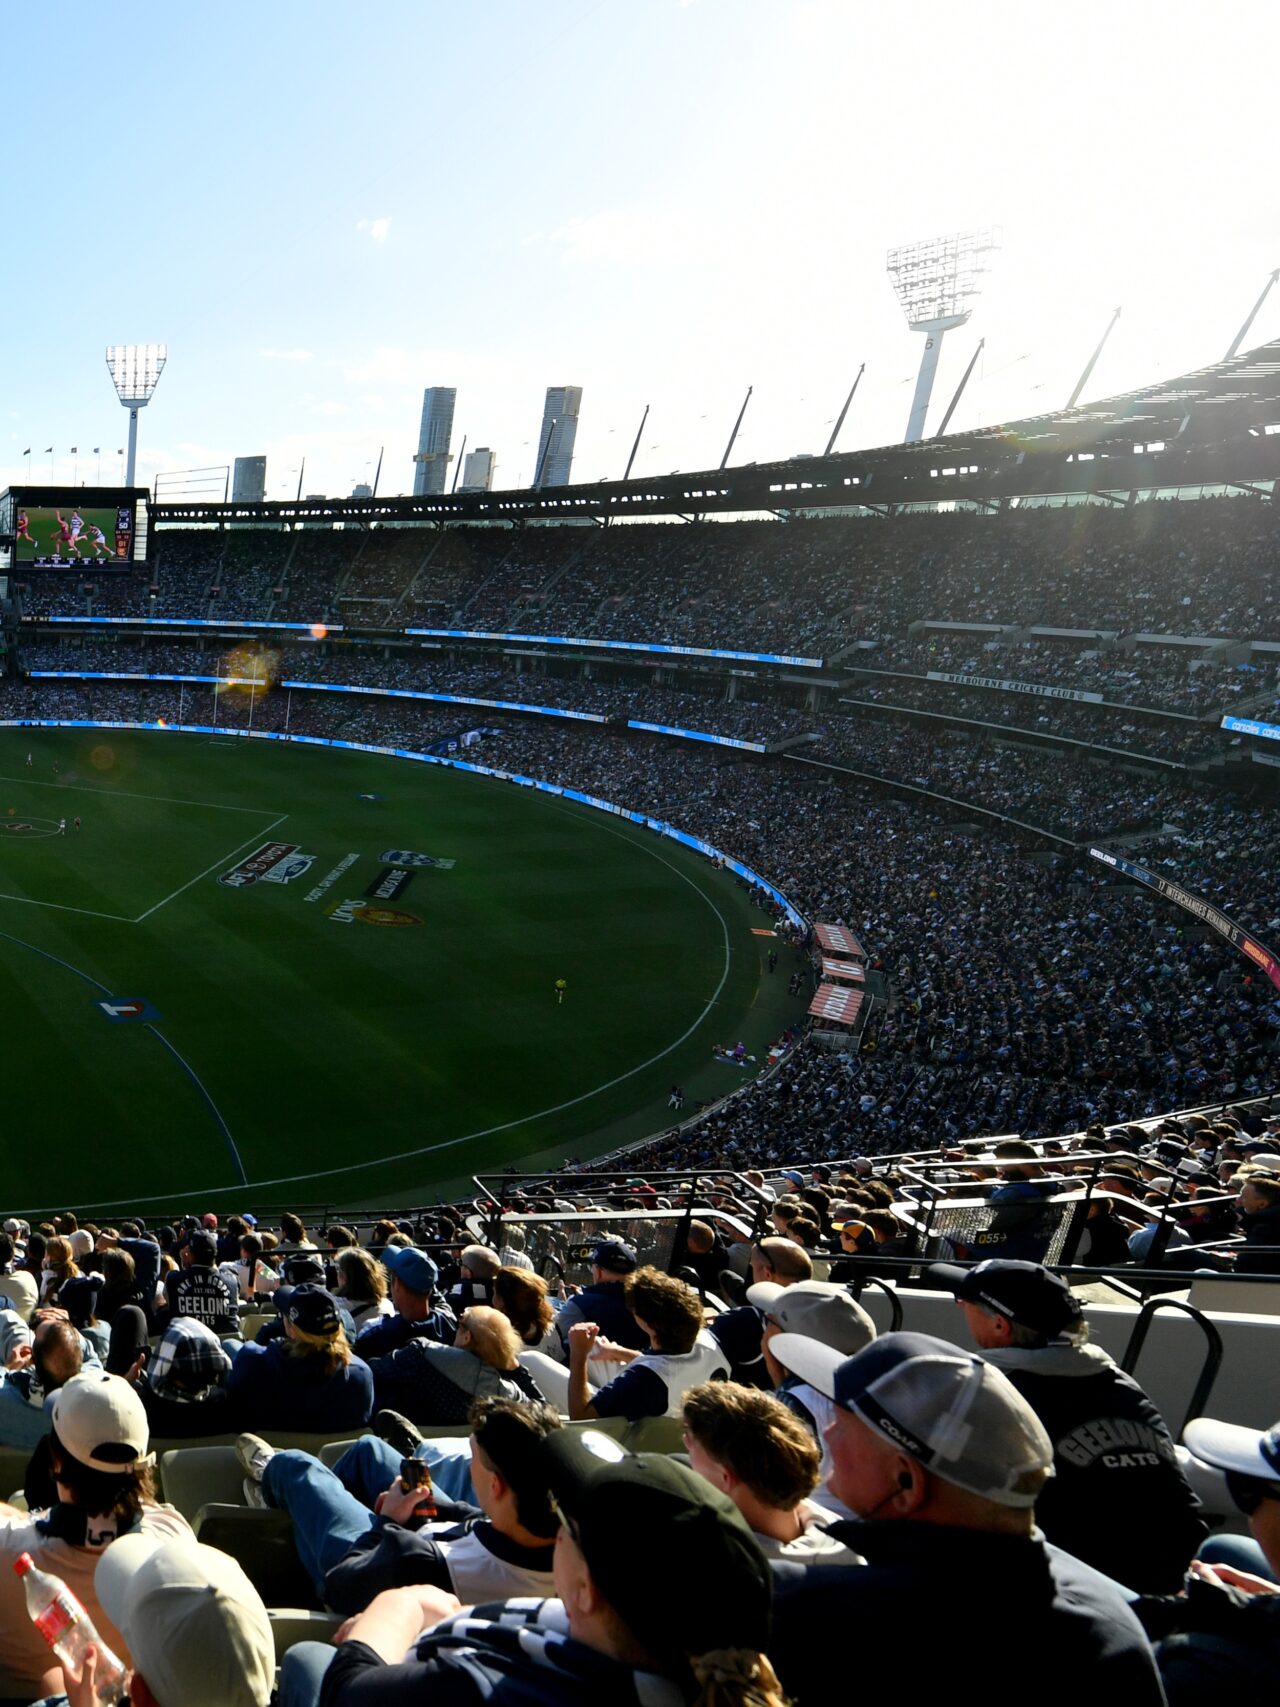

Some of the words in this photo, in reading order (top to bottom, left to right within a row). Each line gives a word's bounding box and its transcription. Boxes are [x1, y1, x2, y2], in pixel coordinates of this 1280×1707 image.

[948, 675, 1003, 688] MELBOURNE
[1008, 682, 1047, 695] CRICKET
[1050, 688, 1075, 699] CLUB
[1165, 885, 1207, 917] INTERCHANGES
[1206, 909, 1231, 936] REMAINING
[978, 1233, 1000, 1245] Q55
[193, 1274, 203, 1284] IN
[177, 1296, 230, 1316] GEELONG
[1056, 1417, 1174, 1469] GEELONG
[1101, 1452, 1160, 1469] CATS
